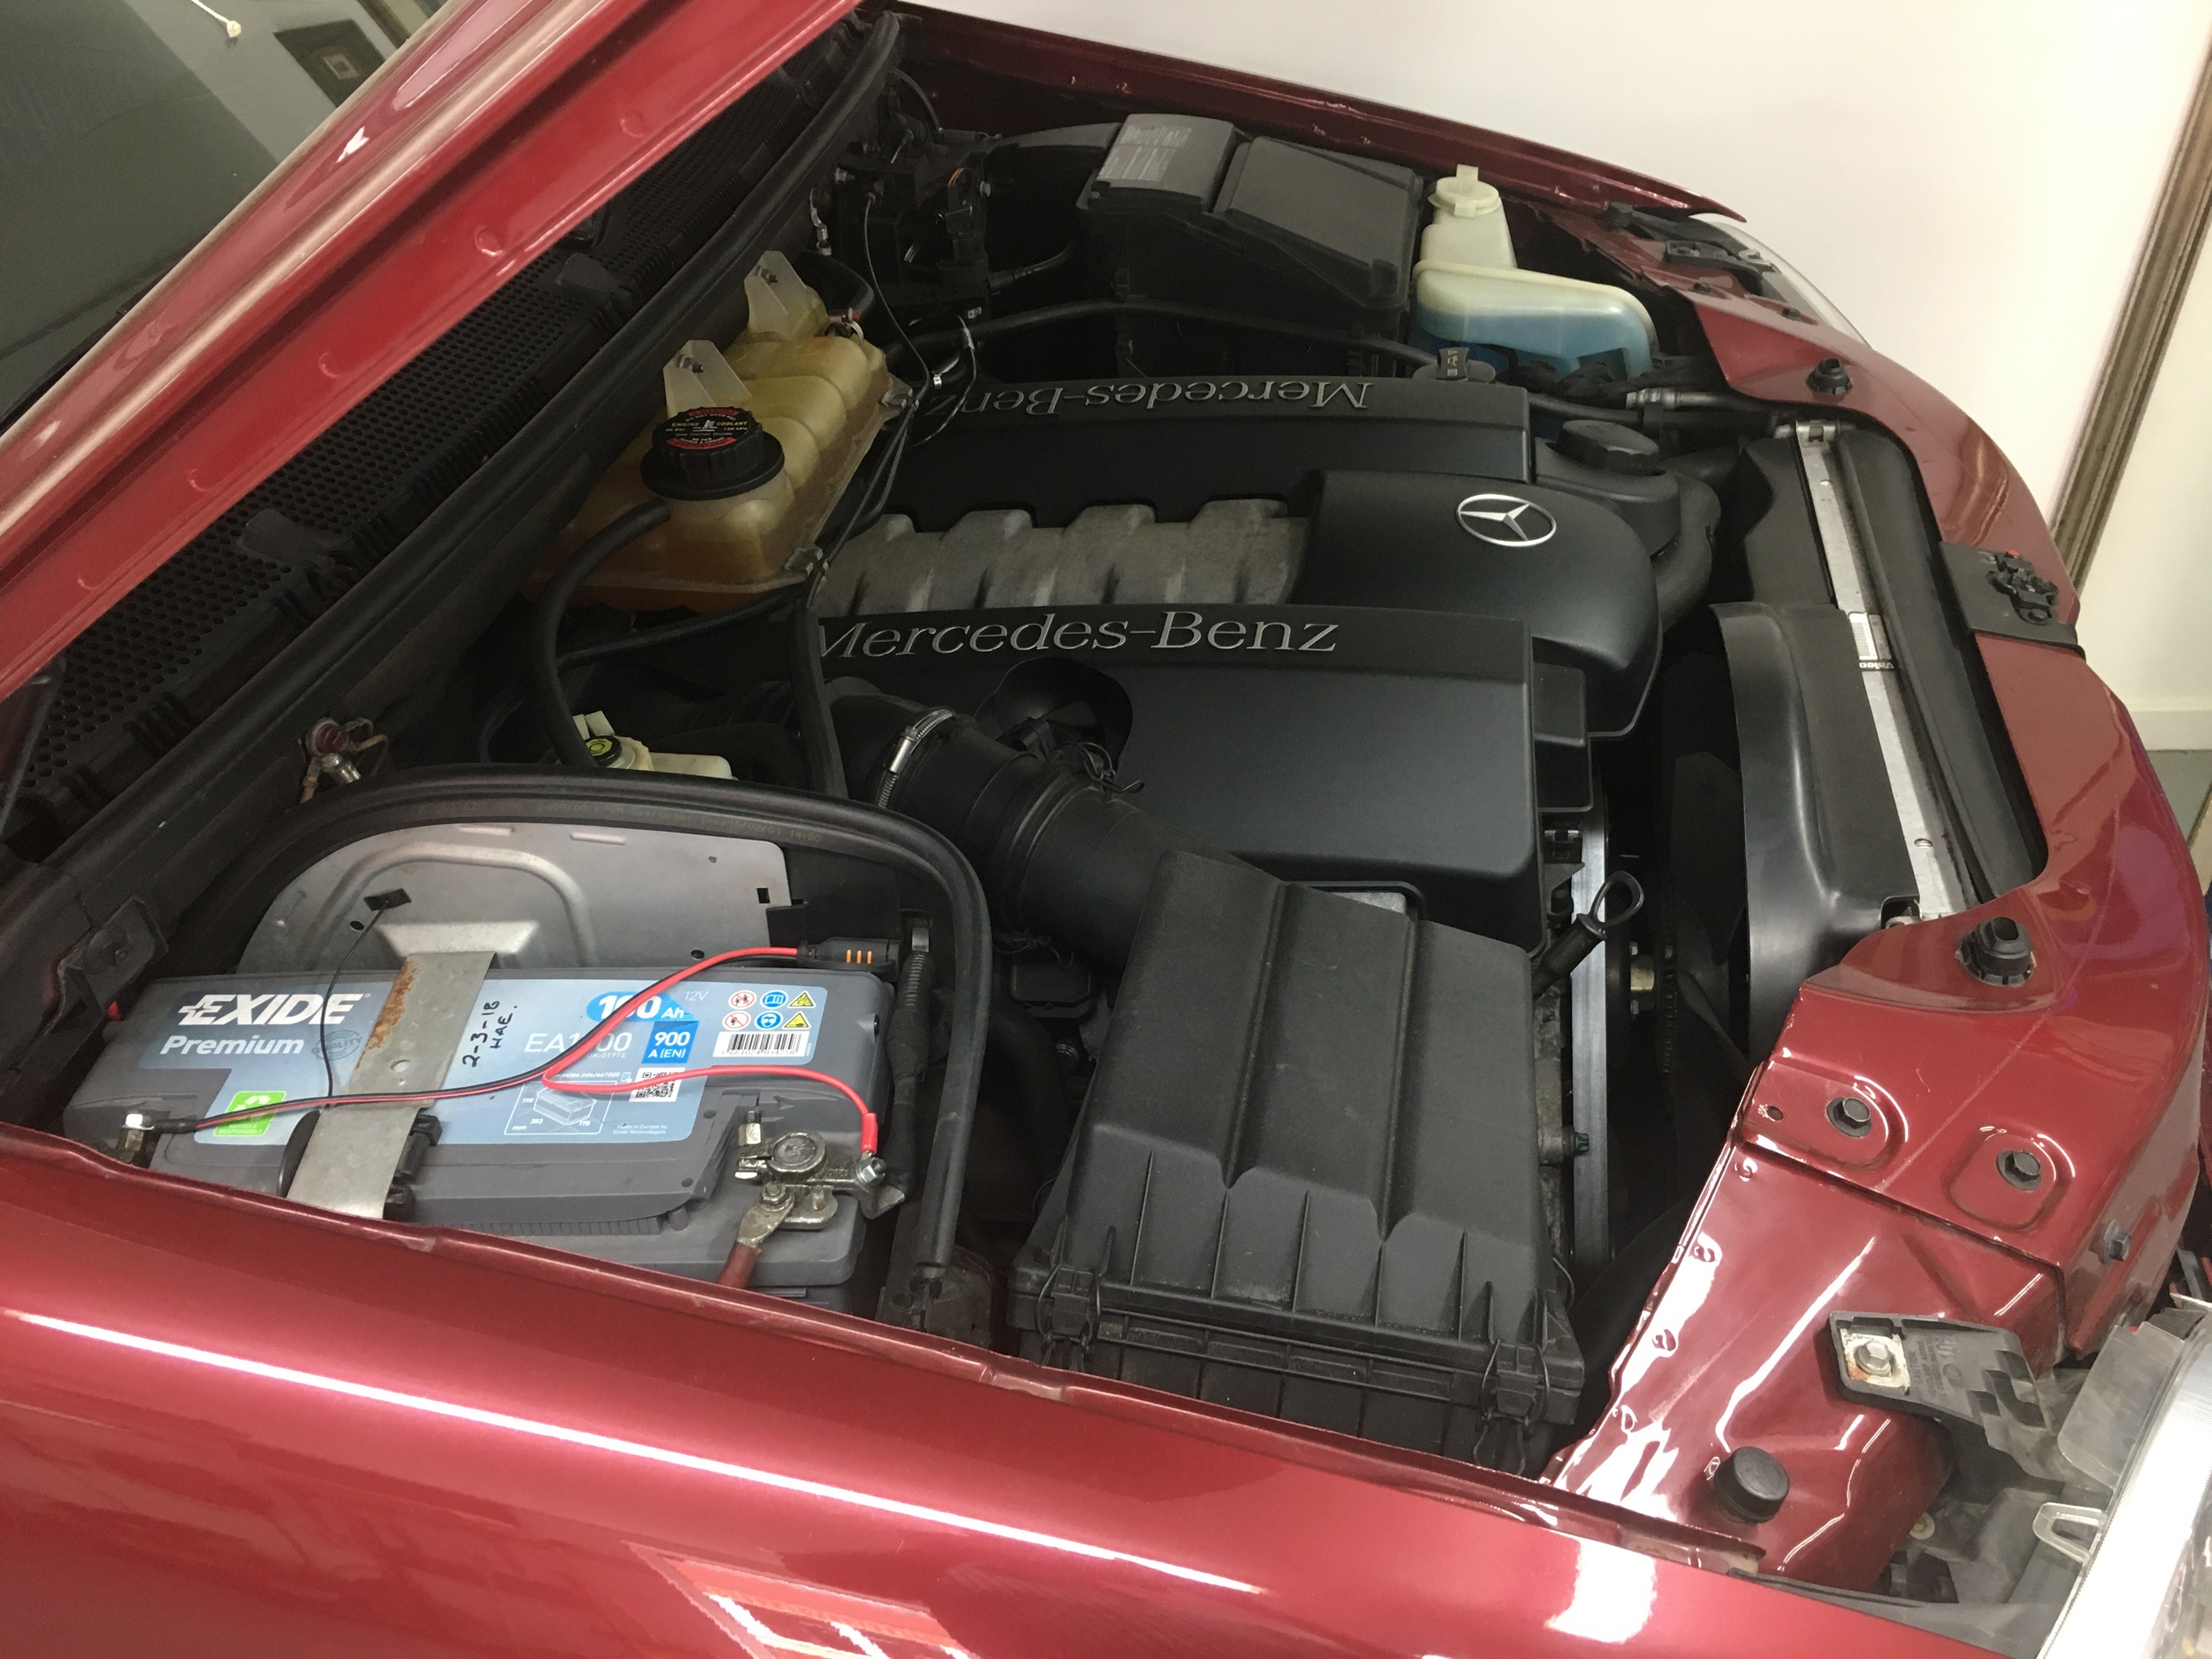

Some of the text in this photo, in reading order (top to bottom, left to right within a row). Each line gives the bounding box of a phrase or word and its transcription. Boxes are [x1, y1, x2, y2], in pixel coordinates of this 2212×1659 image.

[1859, 662, 1895, 670] Valeo
[684, 990, 709, 1002] 12V
[178, 993, 364, 1026] EXIDE
[661, 1007, 684, 1019] Ah
[462, 1000, 501, 1067] 2-3-18
[654, 1031, 691, 1047] 900
[159, 1035, 304, 1055] Premium
[524, 1032, 633, 1053] EA100
[647, 1048, 686, 1059] A (EN)
